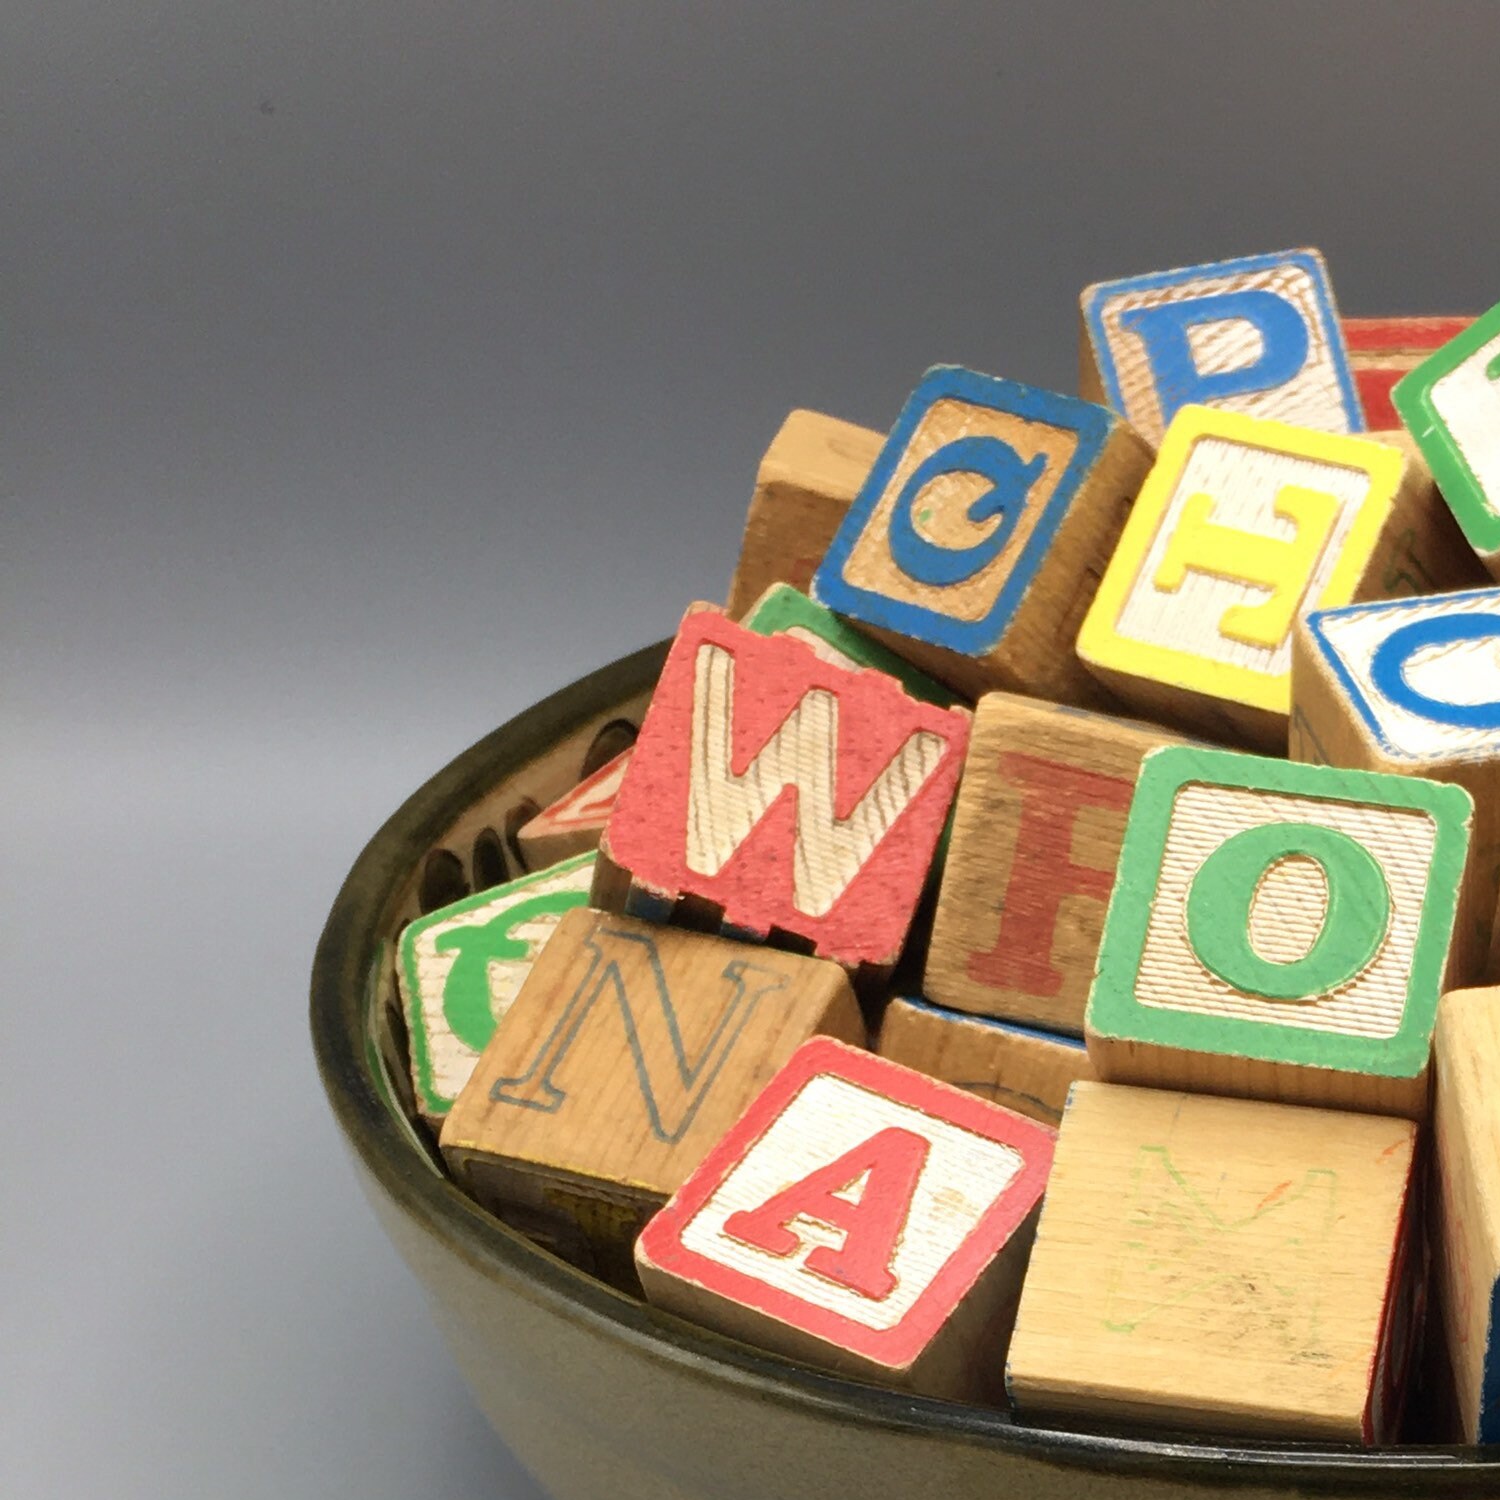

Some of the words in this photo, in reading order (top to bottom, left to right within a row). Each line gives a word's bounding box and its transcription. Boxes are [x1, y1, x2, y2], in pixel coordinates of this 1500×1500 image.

[888, 434, 1048, 587] Q
[686, 642, 950, 919] W
[491, 926, 791, 1145] N
[722, 1125, 898, 1303] A
